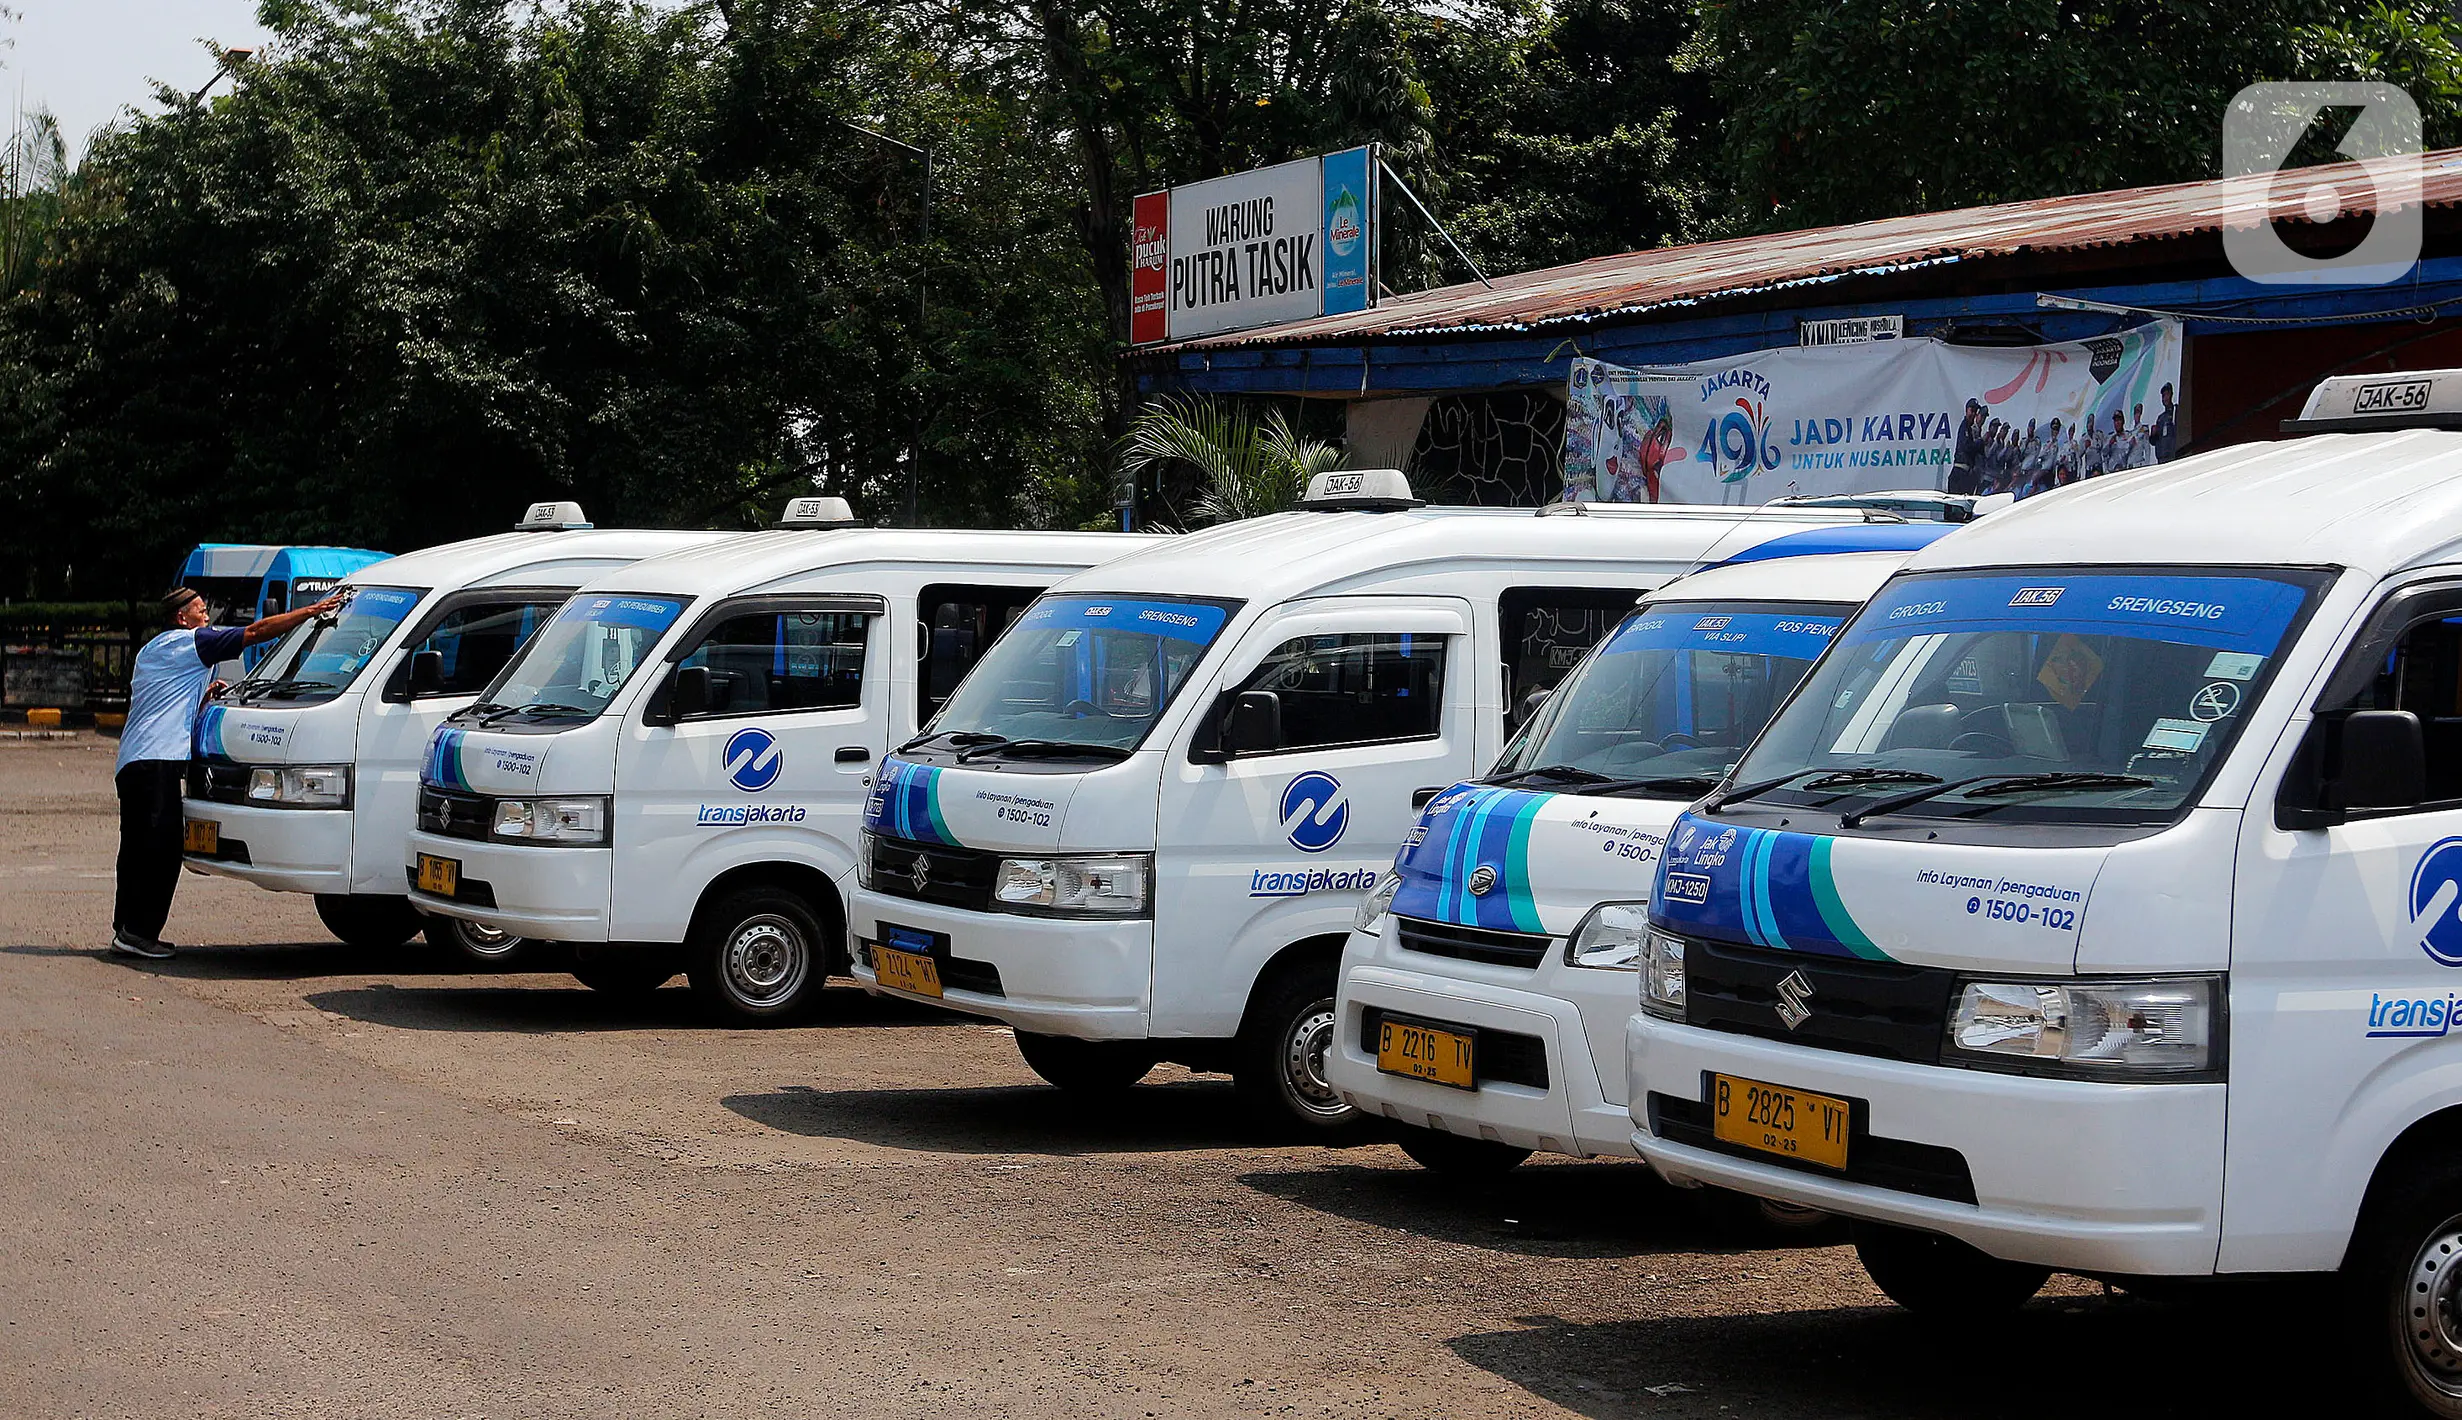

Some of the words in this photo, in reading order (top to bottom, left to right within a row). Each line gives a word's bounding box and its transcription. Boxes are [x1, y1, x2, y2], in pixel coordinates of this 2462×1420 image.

[1206, 196, 1273, 246] WARUNG
[1340, 216, 1348, 228] Le
[1330, 225, 1360, 241] Minerale
[1173, 247, 1240, 311] PUTRA
[1245, 233, 1314, 299] TASIK
[1803, 322, 1838, 346] KAMAR
[1700, 369, 1772, 402] JAKARTA
[2359, 385, 2426, 408] JAK-56
[1790, 418, 1853, 446] JADI
[1861, 412, 1952, 443] KARYA
[1791, 451, 1843, 470] UNTUK
[1849, 447, 1952, 468] NUSANTARA
[1327, 476, 1360, 492] JAK-56
[1138, 609, 1198, 627] SRENGSENG
[1889, 600, 1947, 620] GROGOL
[2107, 595, 2226, 620] SRENGSENG
[1704, 631, 1720, 641] VIA
[1720, 632, 1747, 642] SLIPI
[1774, 620, 1801, 632] POS
[696, 803, 807, 827] transjakarta
[1006, 808, 1050, 827] 1500-102
[1571, 819, 1588, 830] Info
[1588, 821, 1628, 836] Layanan
[1699, 835, 1720, 850] Jak
[1693, 850, 1726, 870] Lingko
[1248, 867, 1377, 898] transjakarta
[1667, 879, 1706, 897] KMJ-1250
[1916, 869, 1939, 884] Info
[1940, 872, 1993, 890] Layanan
[1986, 899, 2075, 931] 1500-102
[872, 948, 880, 971] B
[886, 952, 912, 978] 2124
[1382, 1025, 1392, 1052] B
[1402, 1028, 1436, 1061] 2216
[1453, 1038, 1471, 1070] TV
[1719, 1080, 1731, 1116] B
[1747, 1086, 1795, 1132] 2825
[1823, 1103, 1845, 1144] VT
